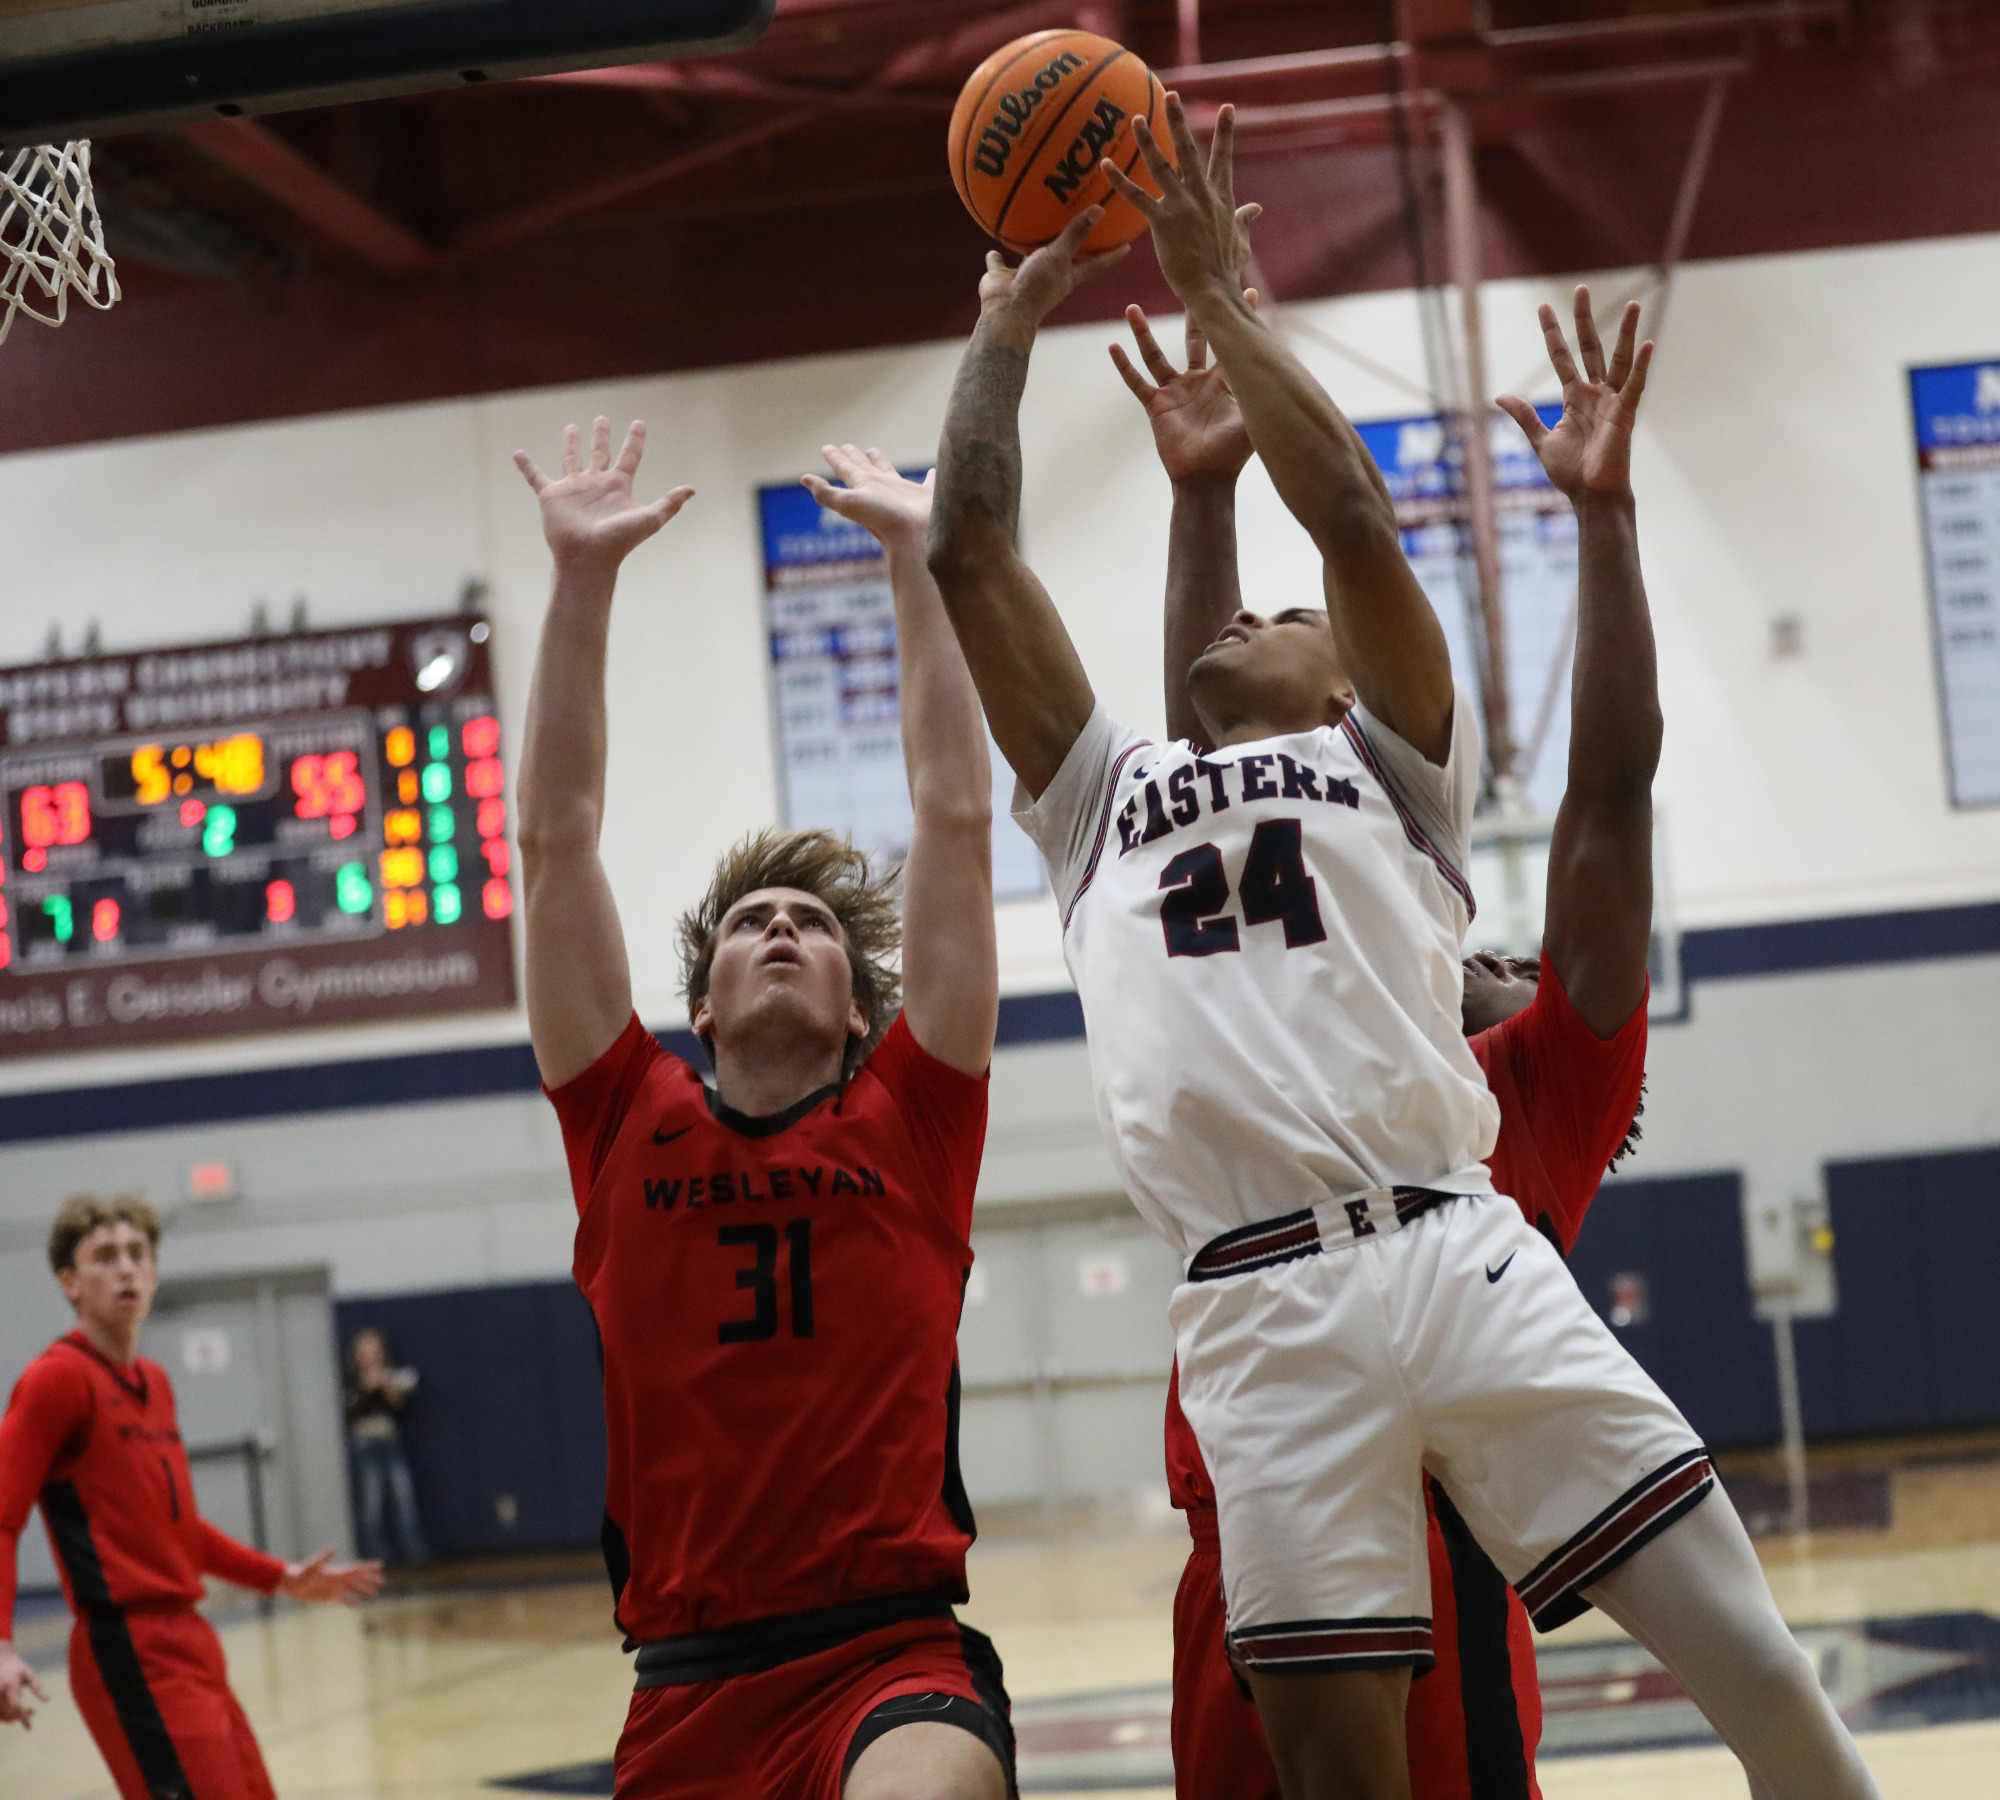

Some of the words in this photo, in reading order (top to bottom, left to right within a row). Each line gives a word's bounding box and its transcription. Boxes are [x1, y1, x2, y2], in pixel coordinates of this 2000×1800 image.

[974, 52, 1087, 178] Wilson
[1043, 96, 1127, 204] NCAA
[1117, 753, 1360, 860] EASTERN
[1158, 818, 1328, 958] 24
[644, 1166, 886, 1210] WESLEYAN
[1343, 1198, 1377, 1239] E
[717, 1218, 815, 1345] 31
